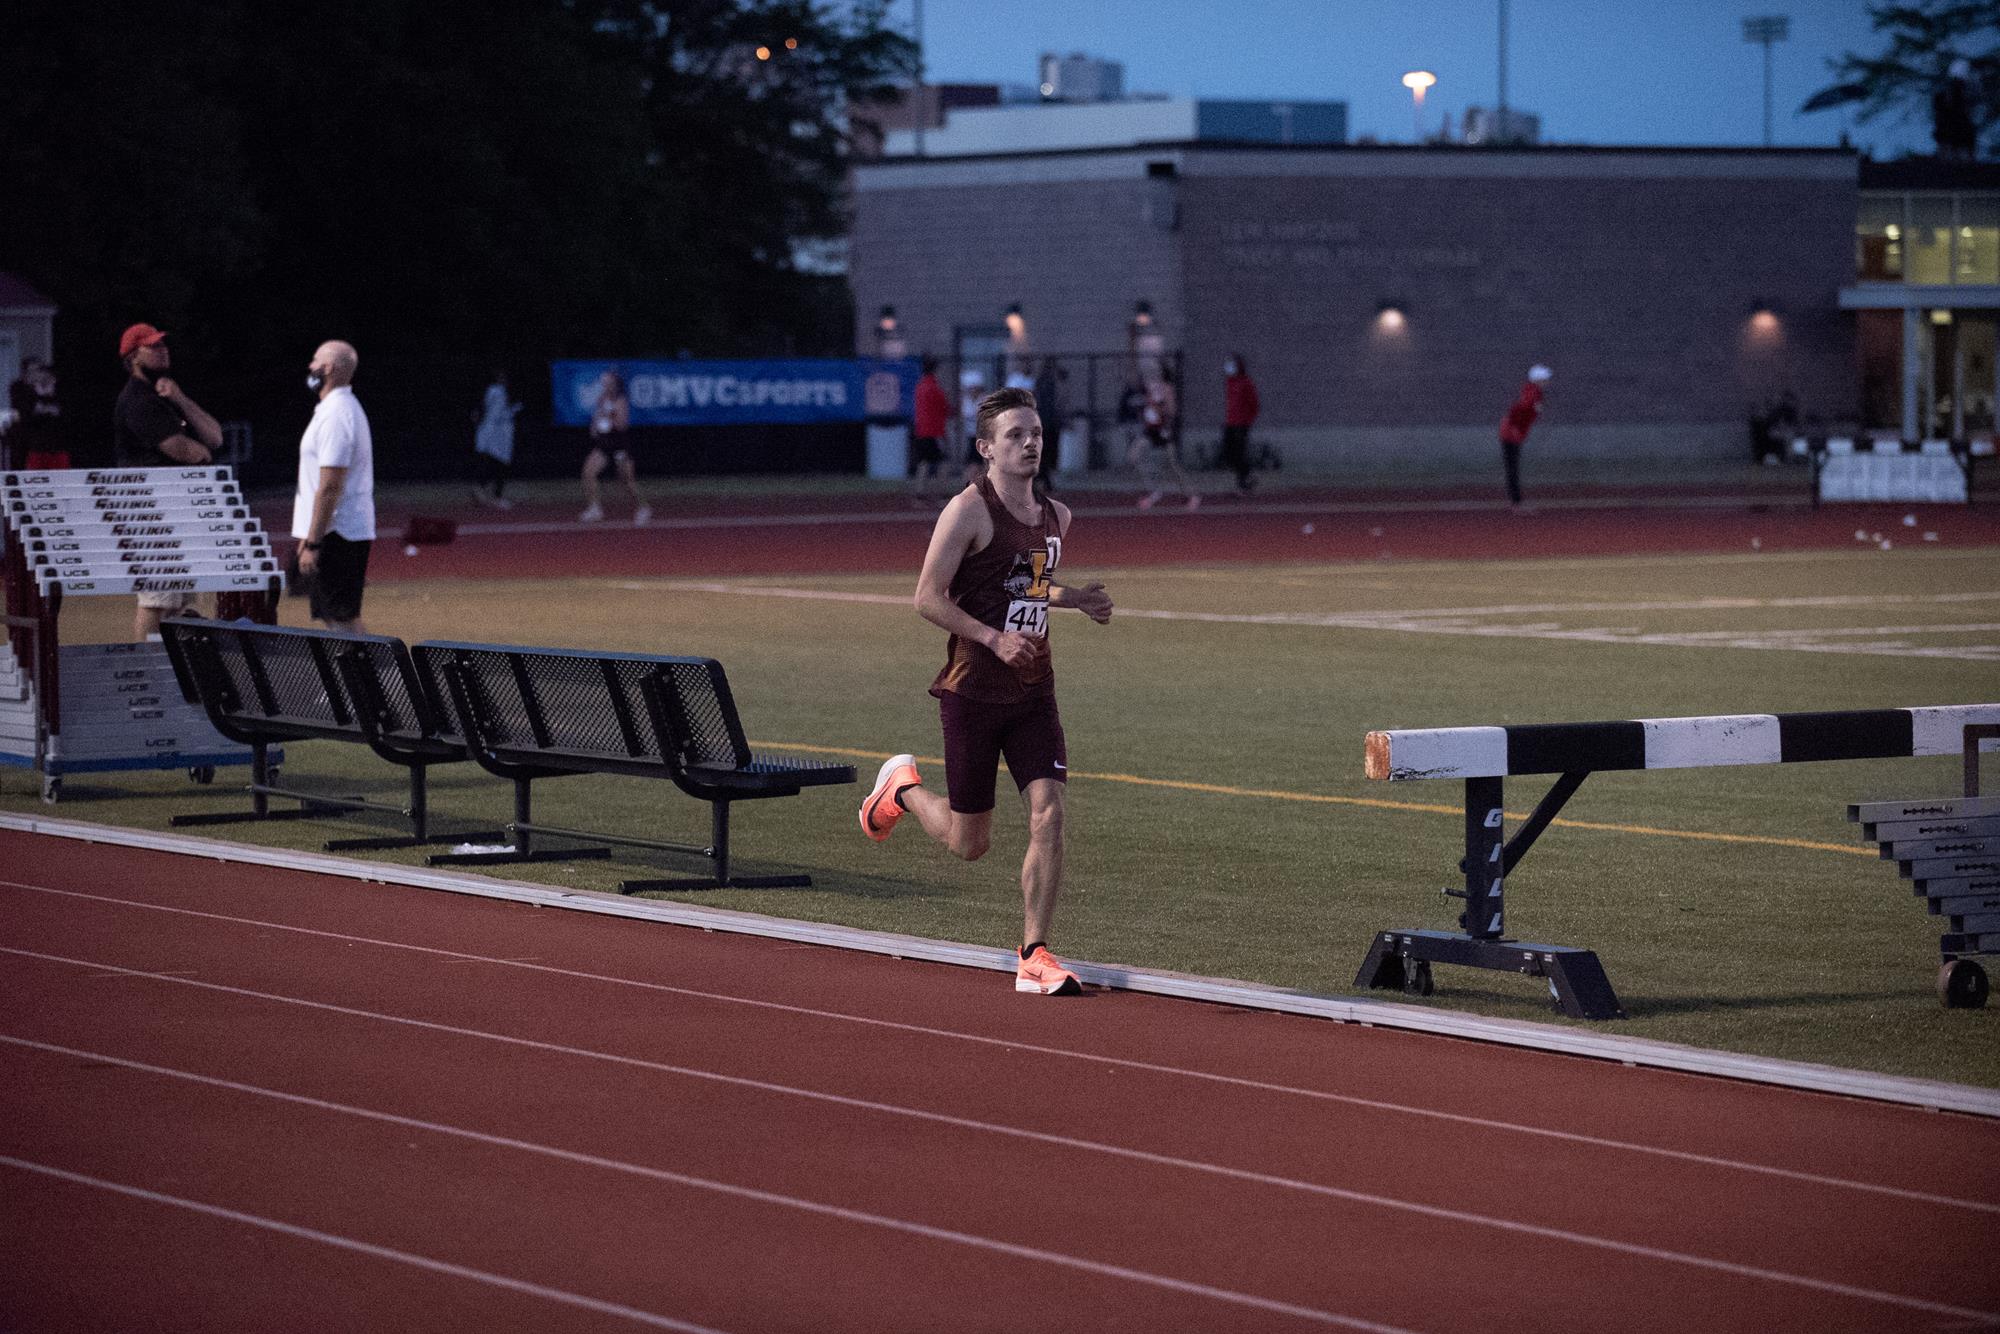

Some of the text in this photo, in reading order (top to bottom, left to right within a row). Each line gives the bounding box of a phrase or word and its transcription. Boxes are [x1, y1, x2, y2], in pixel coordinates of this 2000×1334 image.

[23, 476, 50, 484] UCS
[27, 491, 54, 499] UCS
[31, 503, 58, 511] UCS
[198, 511, 224, 519] UCS
[208, 524, 234, 532] UCS
[52, 543, 80, 551] UCS
[216, 539, 242, 547] UCS
[55, 557, 82, 565] UCS
[63, 569, 90, 577] UCS
[225, 563, 251, 571] UCS
[232, 577, 258, 585] UCS
[1008, 606, 1047, 632] 447
